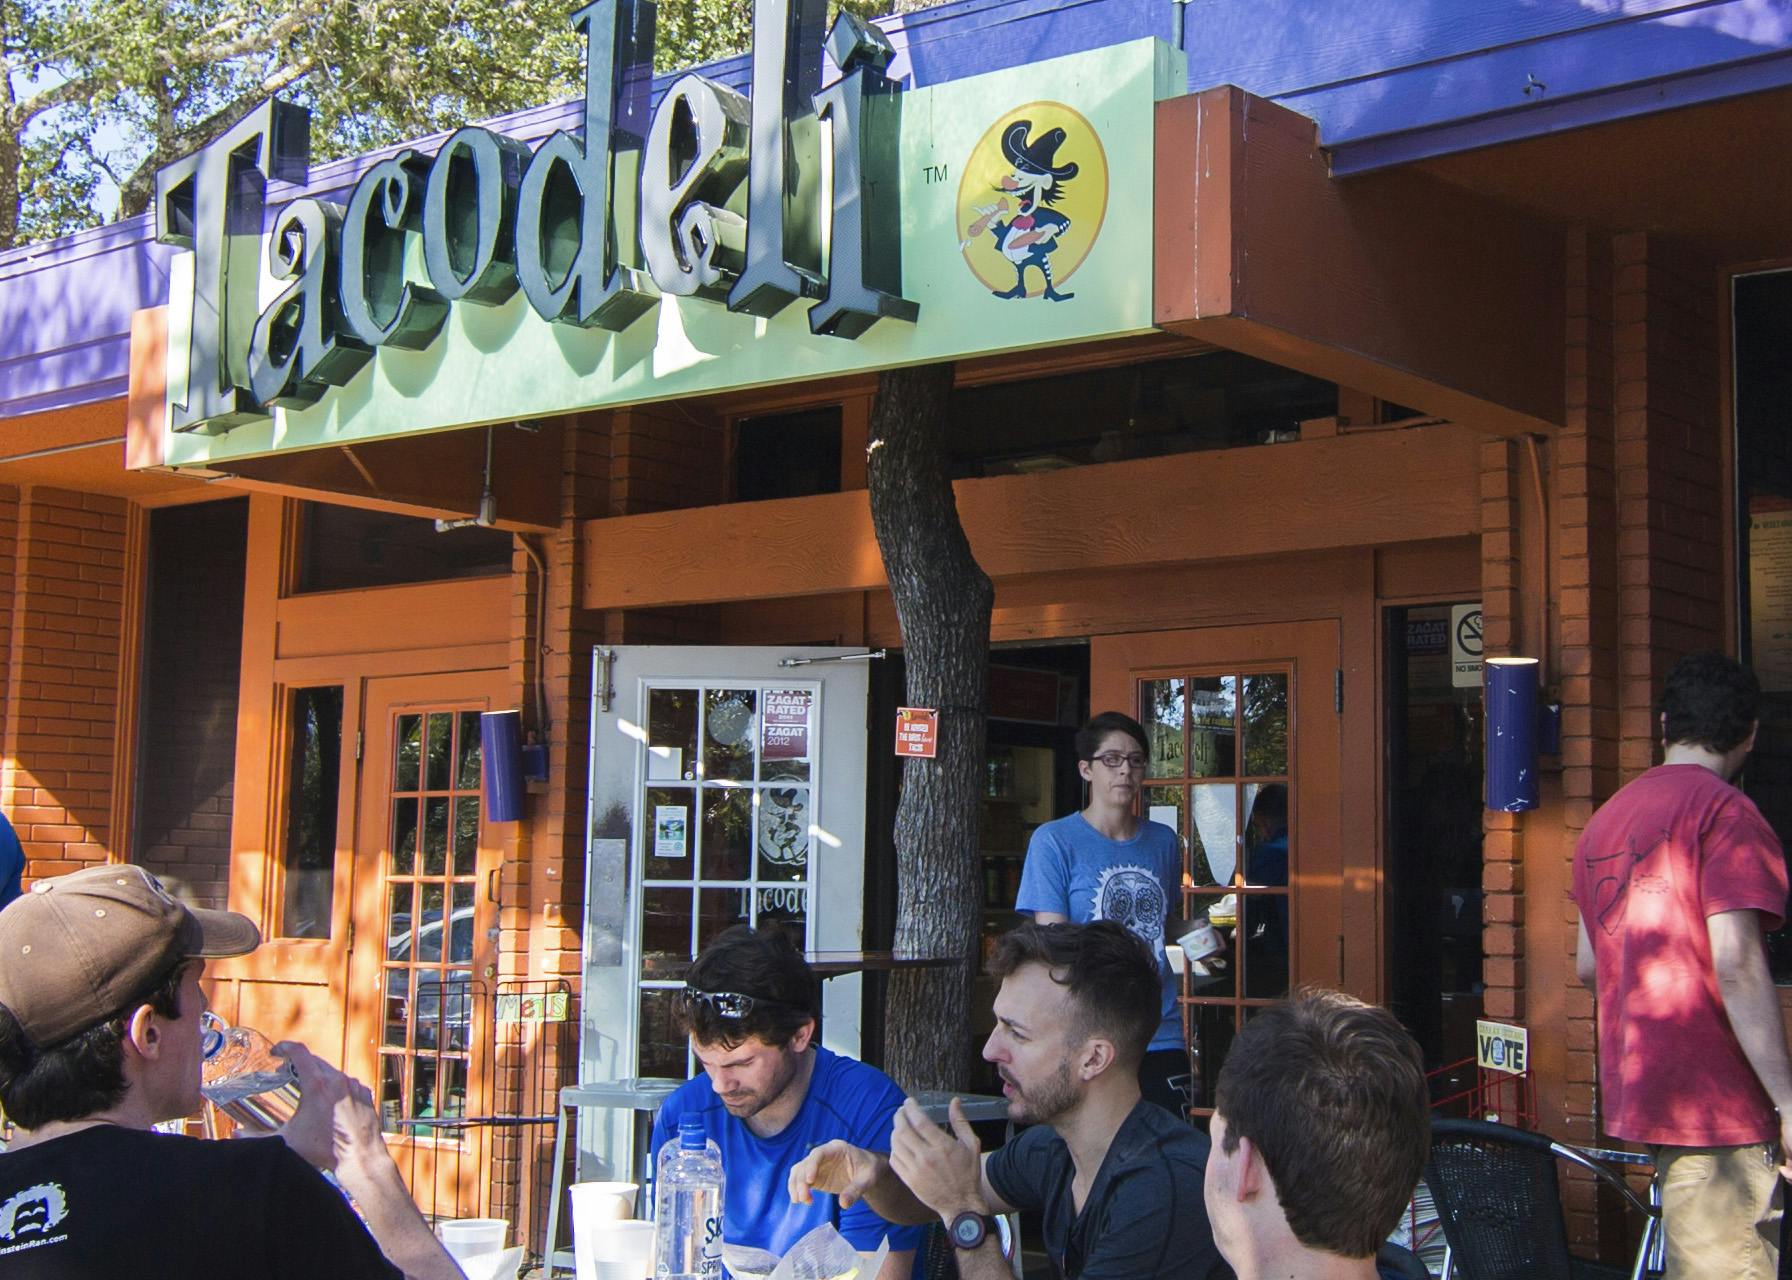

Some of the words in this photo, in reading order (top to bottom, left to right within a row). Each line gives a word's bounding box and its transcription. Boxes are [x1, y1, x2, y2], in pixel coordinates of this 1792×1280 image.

[922, 163, 948, 185] TM
[1407, 622, 1446, 634] ZAGAT
[1407, 633, 1447, 645] RATED
[1455, 664, 1466, 673] NO
[767, 694, 806, 705] ZAGAT
[766, 705, 806, 715] RATED
[768, 726, 805, 736] ZAGAT
[767, 736, 790, 746] 2012
[1479, 1034, 1524, 1071] VOTE
